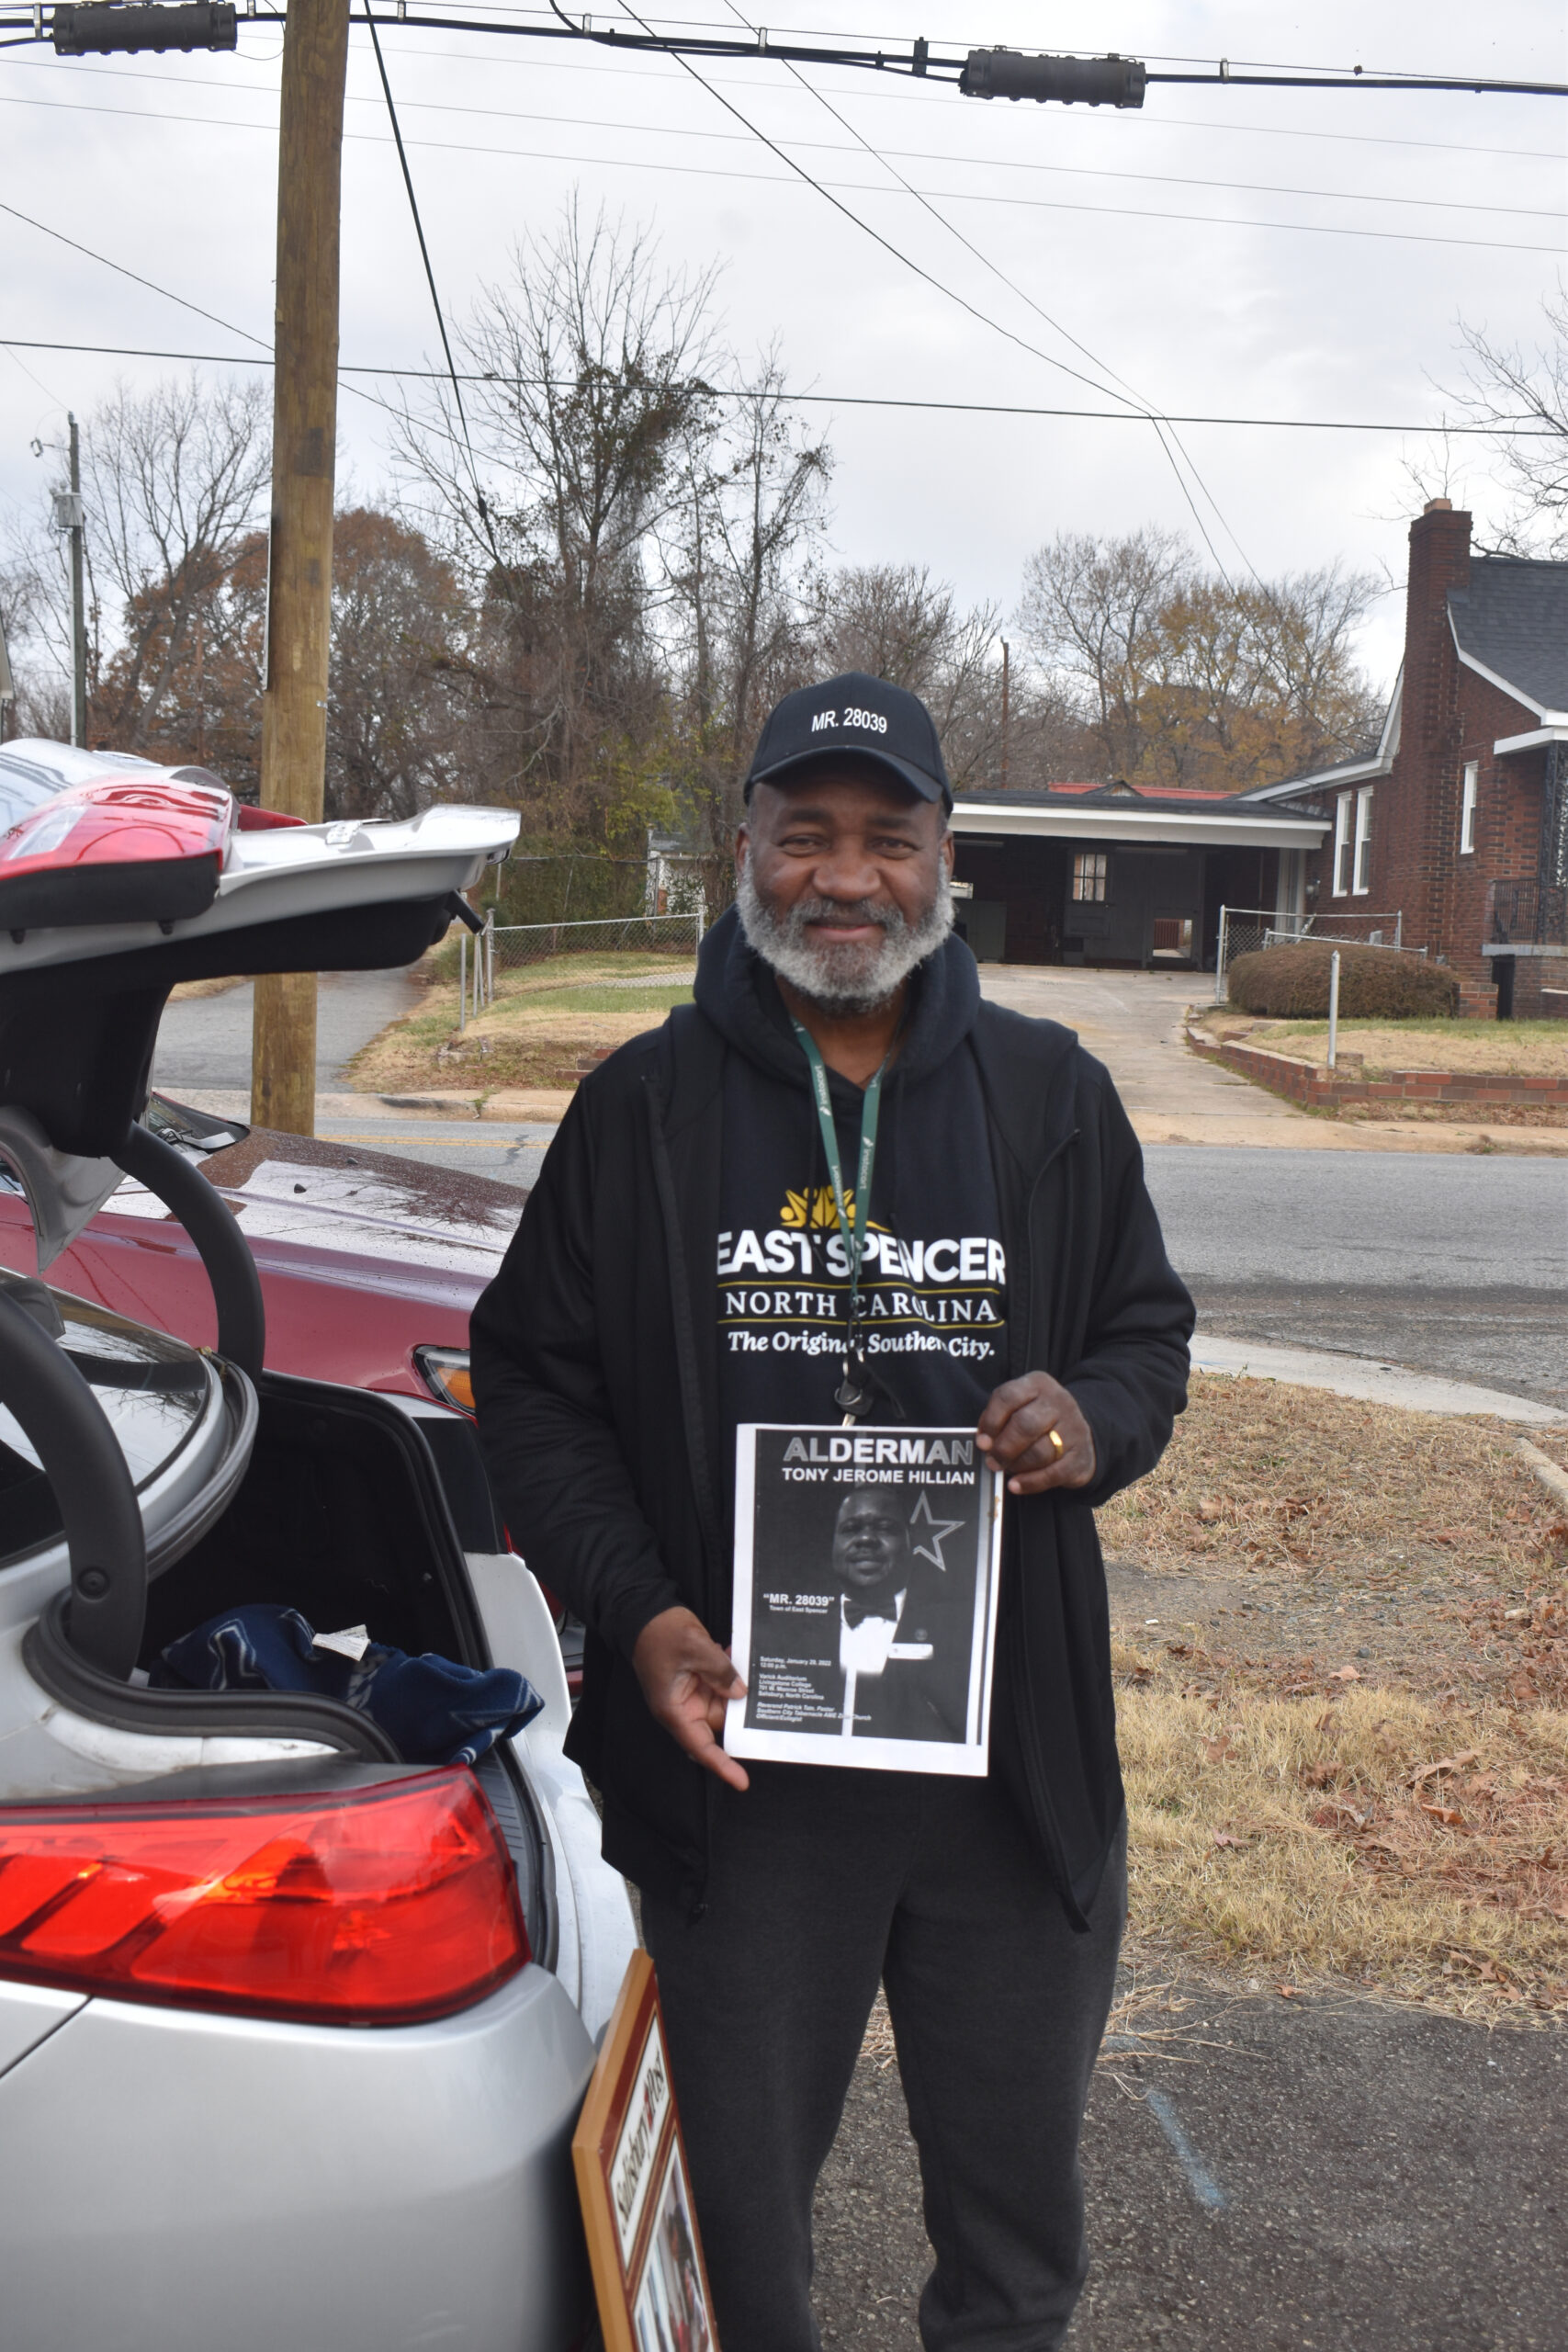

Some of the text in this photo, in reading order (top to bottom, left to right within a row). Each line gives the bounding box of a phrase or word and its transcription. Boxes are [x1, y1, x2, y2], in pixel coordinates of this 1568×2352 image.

[811, 707, 887, 733] MR. 28039
[860, 1148, 872, 1190] instacart
[716, 1229, 821, 1275] EAST
[826, 1230, 1006, 1285] SPENCER
[725, 1291, 997, 1322] NORTH CAROLINA
[728, 1330, 770, 1352] The
[948, 1336, 995, 1360] City.
[783, 1437, 974, 1465] ALDERMAN
[782, 1467, 975, 1485] TONY JEROME HILLIAN
